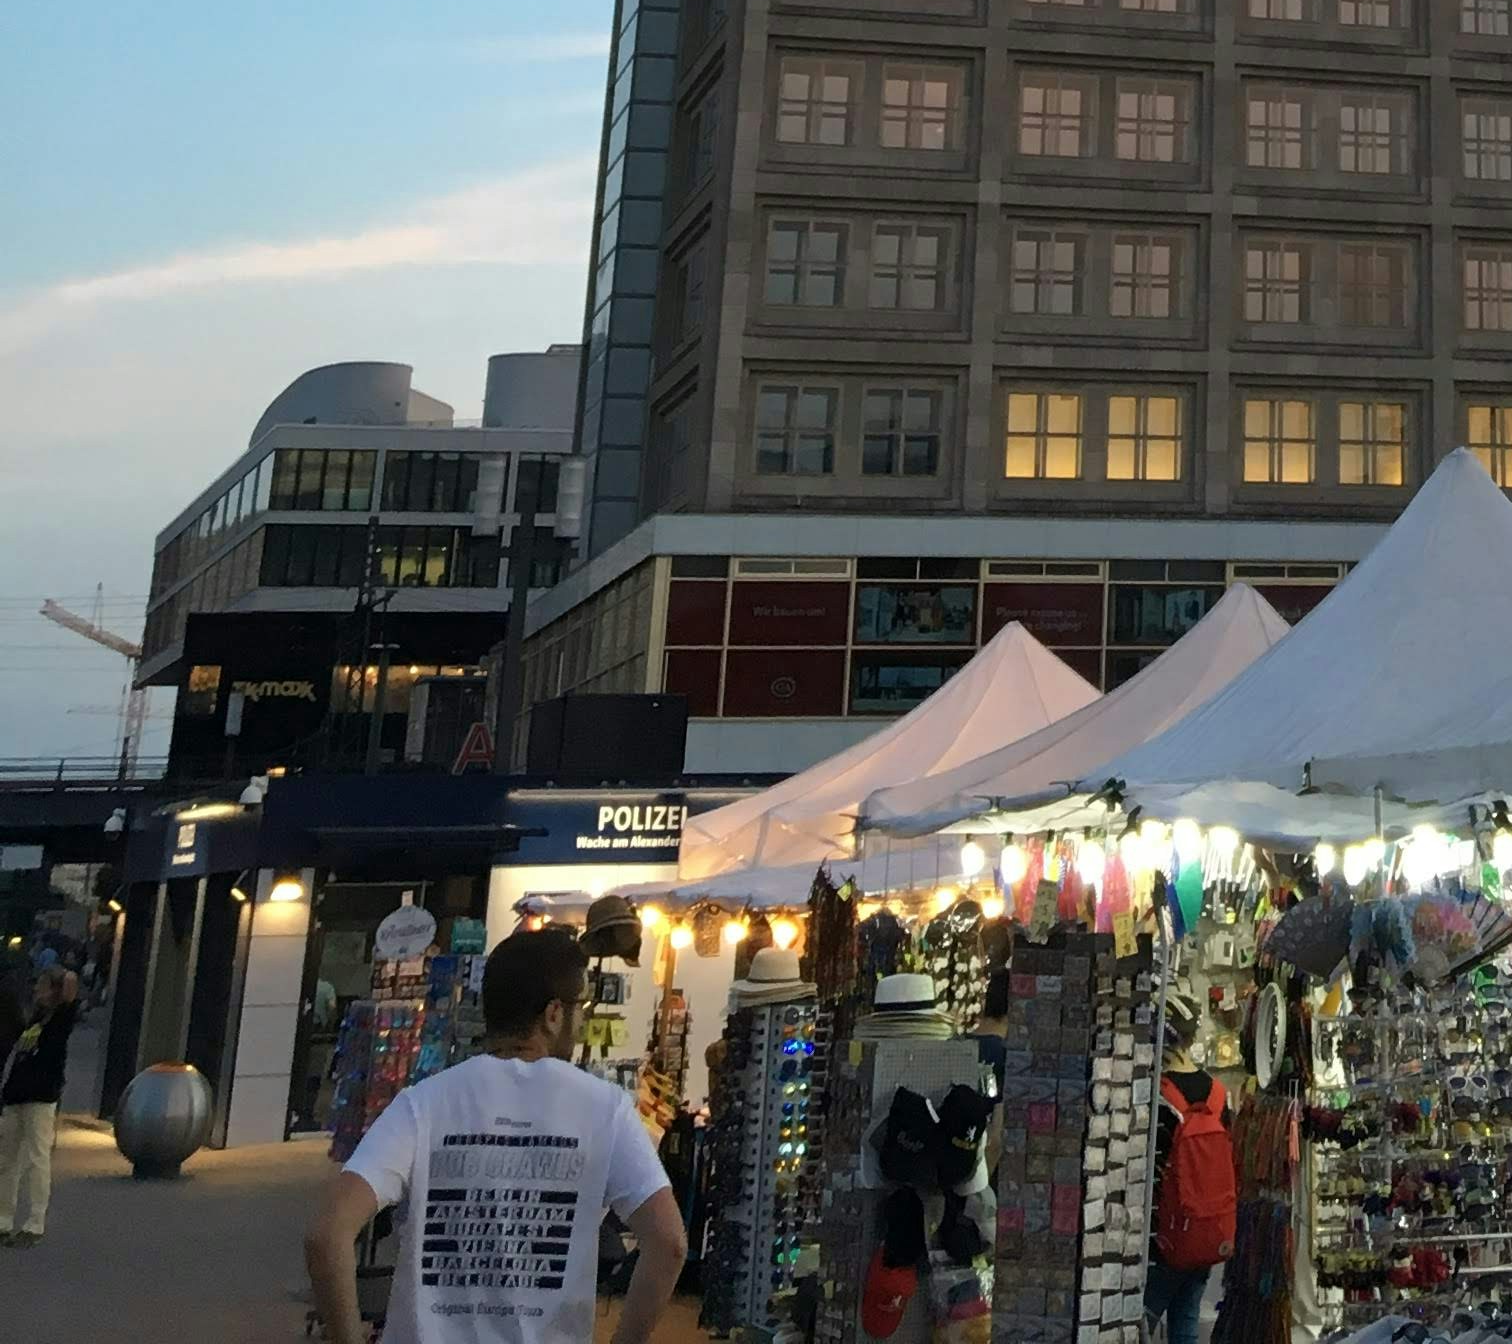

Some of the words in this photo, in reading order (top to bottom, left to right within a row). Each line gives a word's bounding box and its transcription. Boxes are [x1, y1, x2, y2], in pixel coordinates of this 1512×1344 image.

[598, 805, 688, 832] POLIZEI
[576, 836, 610, 849] Wache
[612, 839, 629, 849] am
[630, 835, 680, 849] Alexander
[466, 1188, 542, 1203] BERLIN
[433, 1205, 568, 1221] AMSTERDAM
[445, 1222, 549, 1238] BUDAPEST
[458, 1239, 533, 1255] VIENNA
[431, 1256, 551, 1273] BARCELONA
